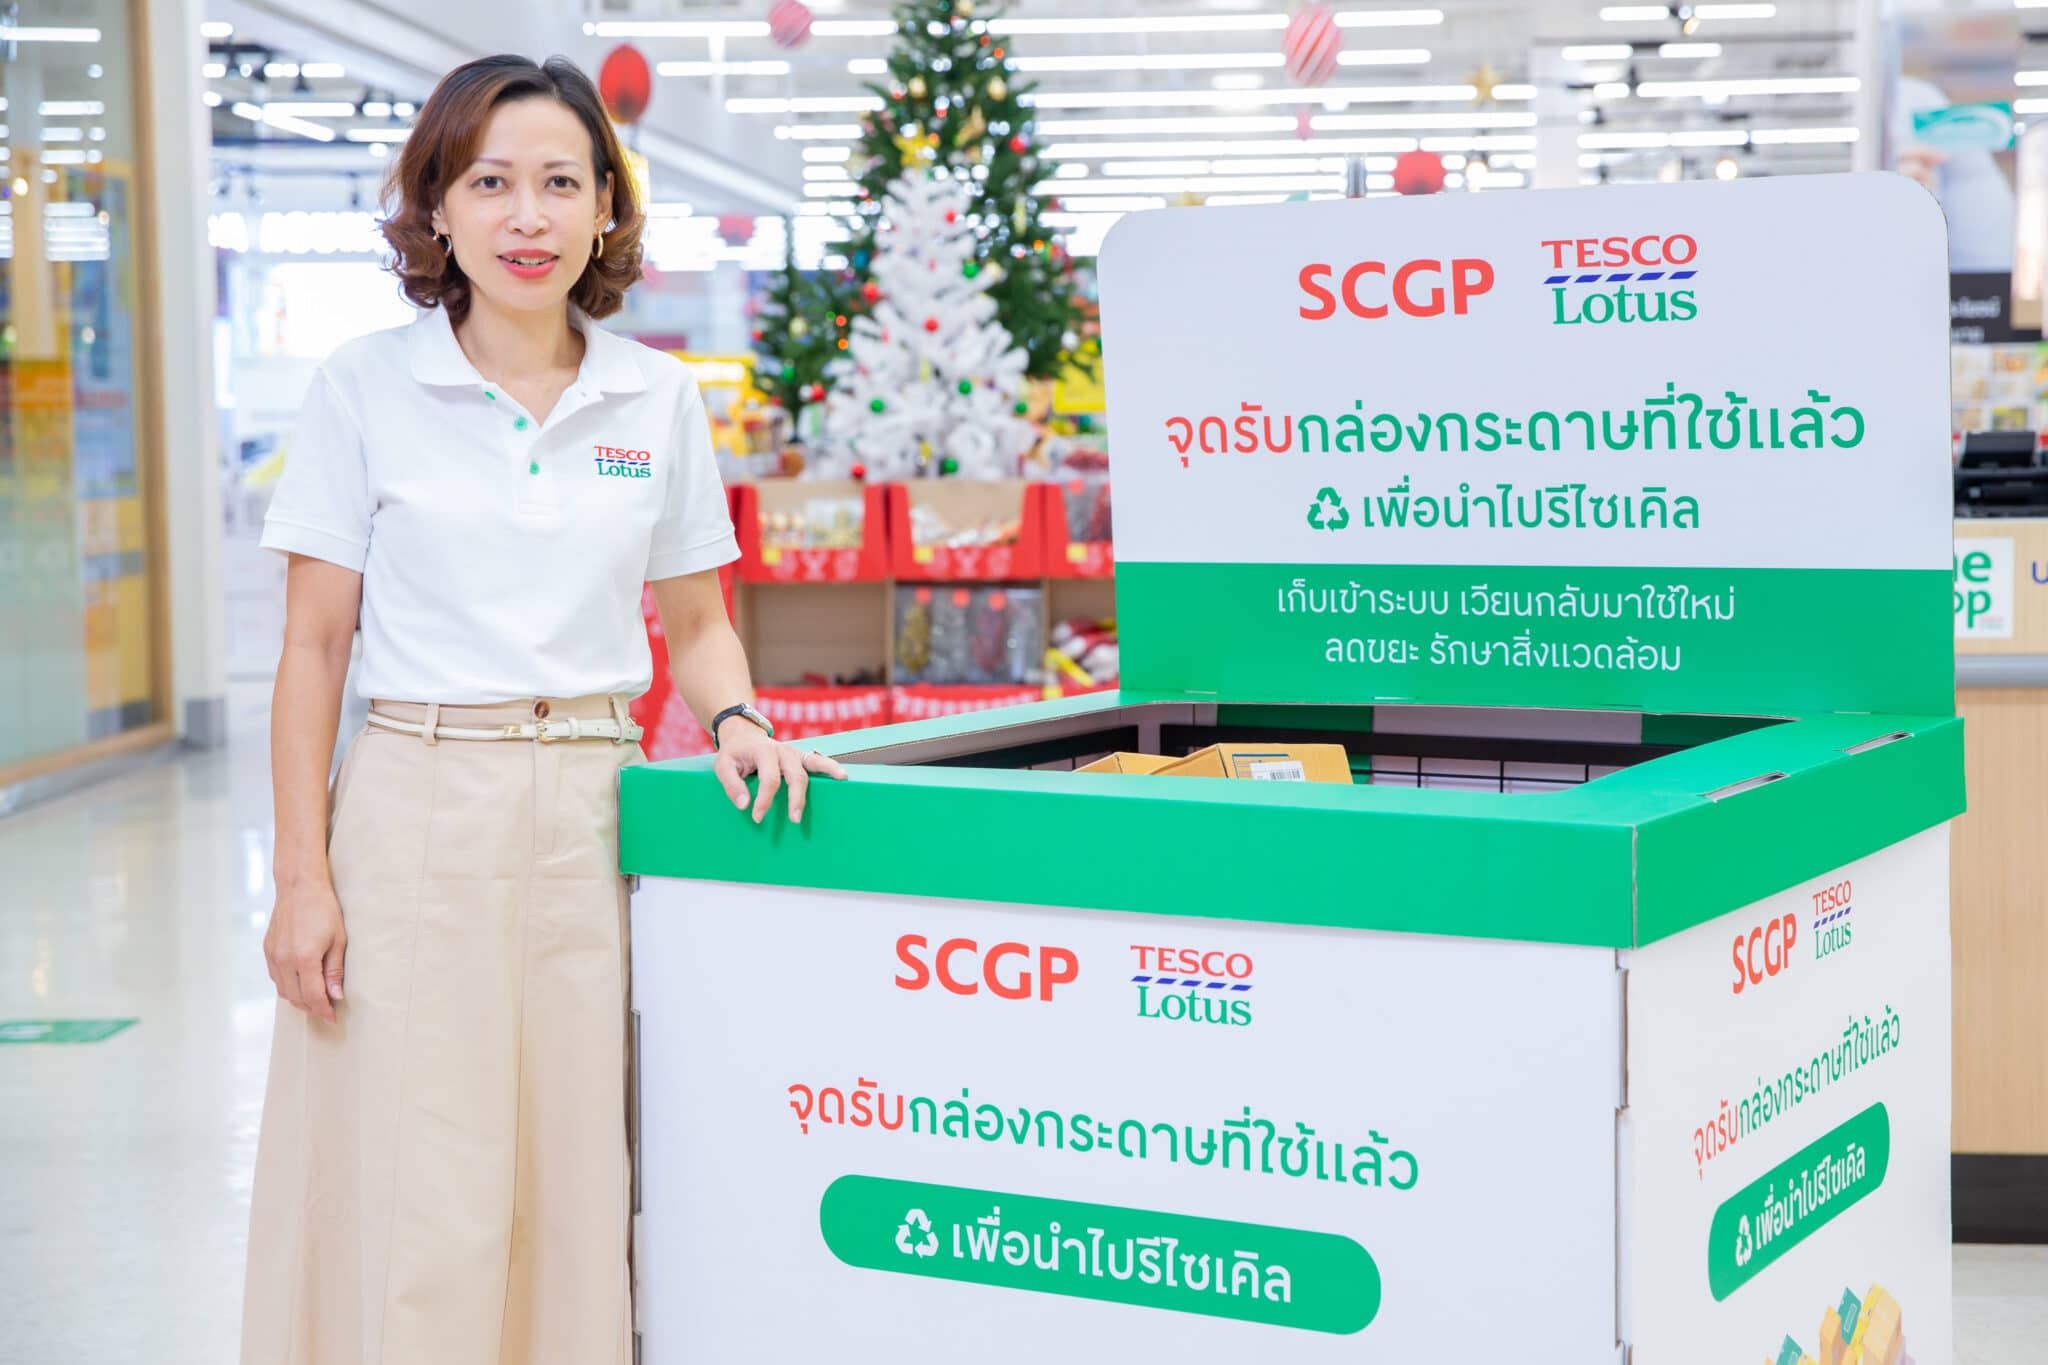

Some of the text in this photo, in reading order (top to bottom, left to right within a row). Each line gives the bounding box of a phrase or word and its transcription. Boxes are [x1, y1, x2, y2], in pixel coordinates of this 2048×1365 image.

[1540, 234, 1698, 269] TESCO
[1298, 258, 1495, 321] SCGP
[1552, 283, 1698, 325] Lotus
[1165, 382, 1865, 469] จุดรับกล่องกระดาษที่ใช้แล้ว
[594, 445, 651, 461] TESCO
[597, 462, 652, 479] Lotus
[1363, 475, 1700, 529] เพื่อนำไปรีไซเคิล
[1278, 579, 1735, 620] เก็บเข้าระบบ เวียนกลับมาใช้ใหม่
[1325, 628, 1681, 671] ลดขยะ รักษาสิ่งแวดล้อม
[1812, 880, 1852, 916] TESCO
[1732, 912, 1797, 995] SCGP
[1814, 921, 1852, 960] Lotus
[895, 934, 1080, 1002] SCGP
[1130, 945, 1254, 979] TESCO
[1137, 985, 1253, 1027] Lotus
[788, 1077, 1419, 1191] จุดรับกล่องกระดาษที่ใช้แล้ว
[1755, 1143, 1866, 1253] เพื่อนำไปรีไซเคิล
[951, 1205, 1293, 1303] เพื่อนำไปรีไซเคิล
